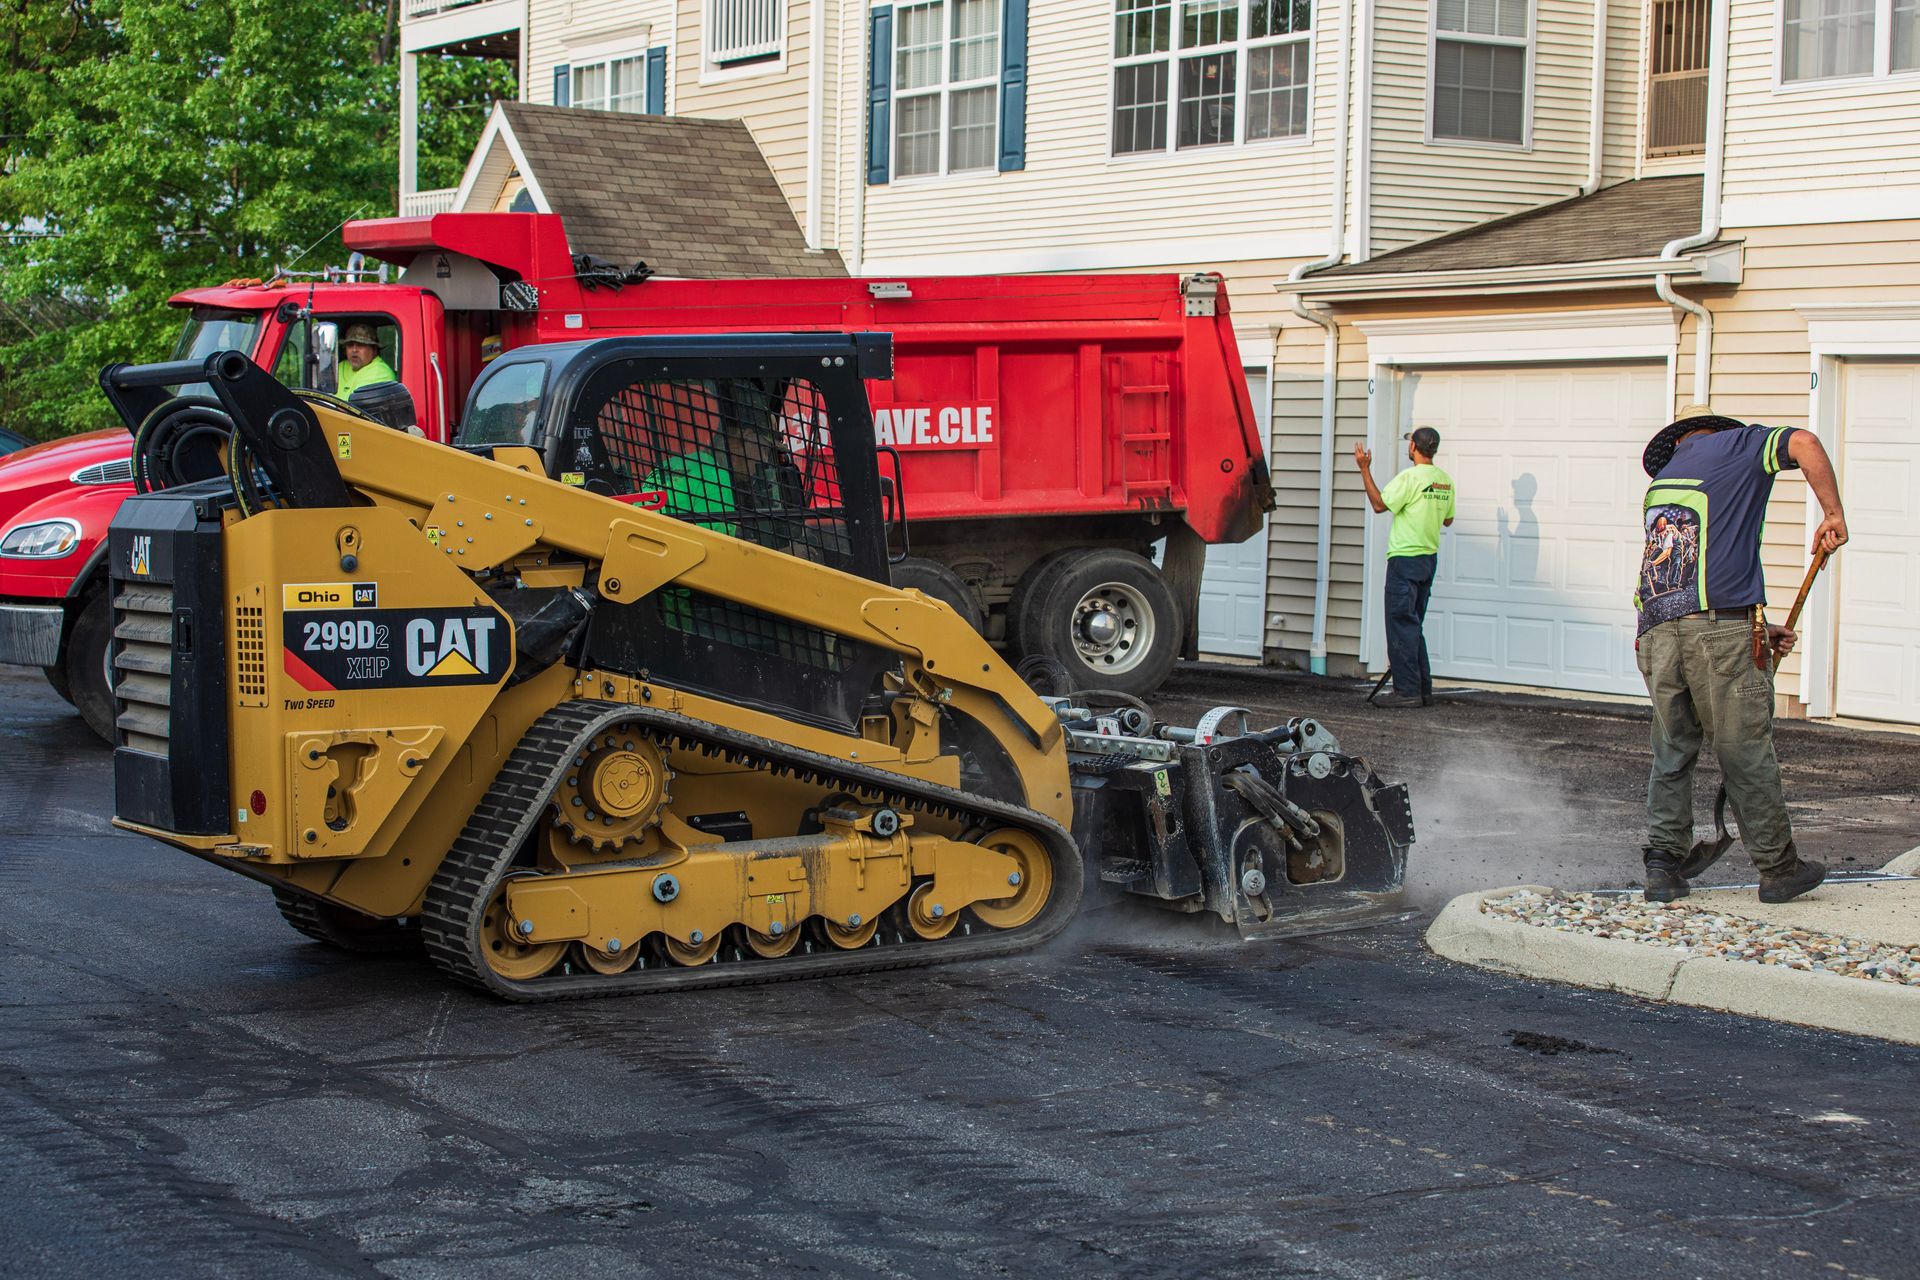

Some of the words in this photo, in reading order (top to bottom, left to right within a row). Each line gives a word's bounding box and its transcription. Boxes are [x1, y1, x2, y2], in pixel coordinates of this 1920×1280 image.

[1368, 379, 1375, 395] C
[1811, 372, 1818, 390] D
[871, 407, 993, 445] AVE.CLE
[131, 535, 151, 576] CAT
[298, 591, 340, 602] Ohio
[355, 589, 374, 602] CAT
[406, 617, 496, 677] CAT
[346, 657, 390, 679] XHP
